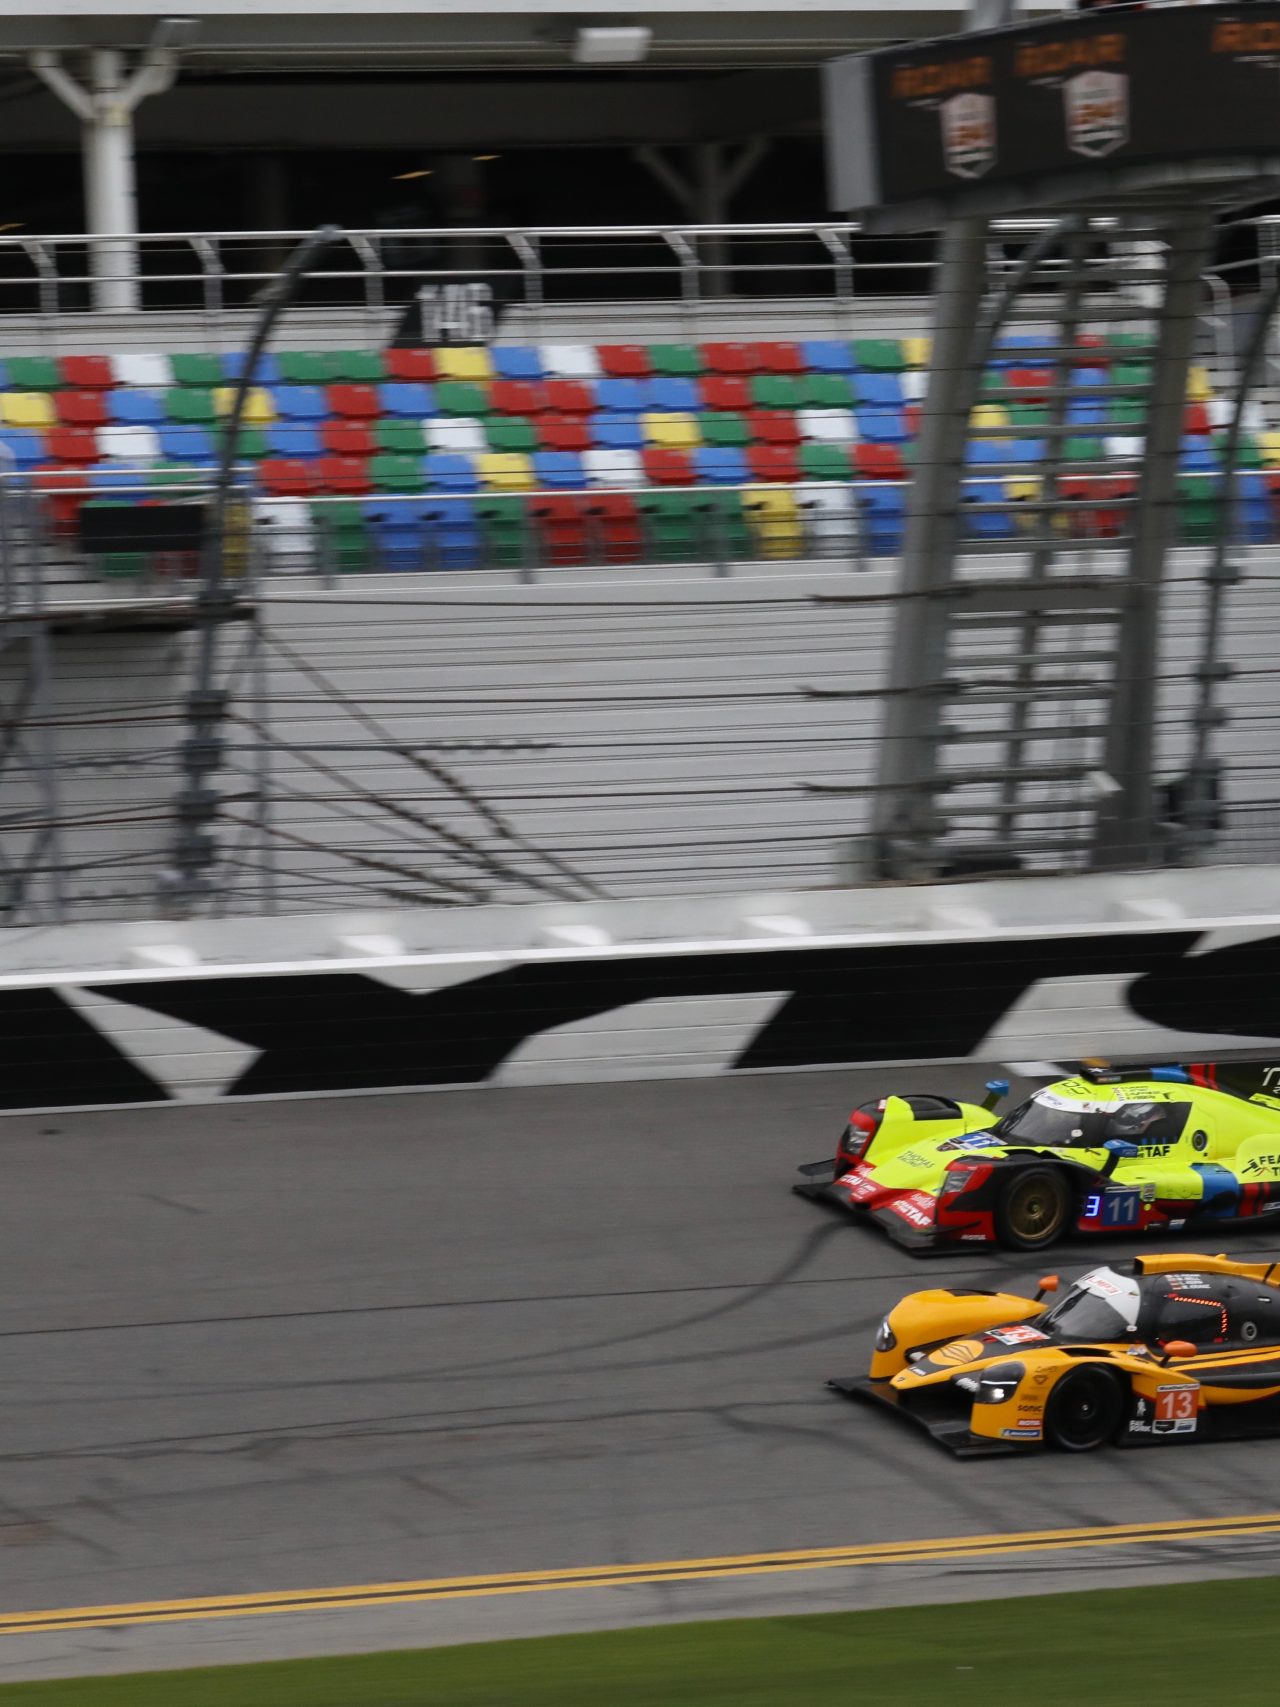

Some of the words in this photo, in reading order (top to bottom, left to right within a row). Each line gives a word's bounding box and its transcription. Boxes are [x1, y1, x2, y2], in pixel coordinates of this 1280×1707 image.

[1145, 1146, 1170, 1158] TAF
[1085, 1195, 1100, 1217] 3
[1108, 1196, 1136, 1222] 11
[1162, 1391, 1193, 1419] 13
